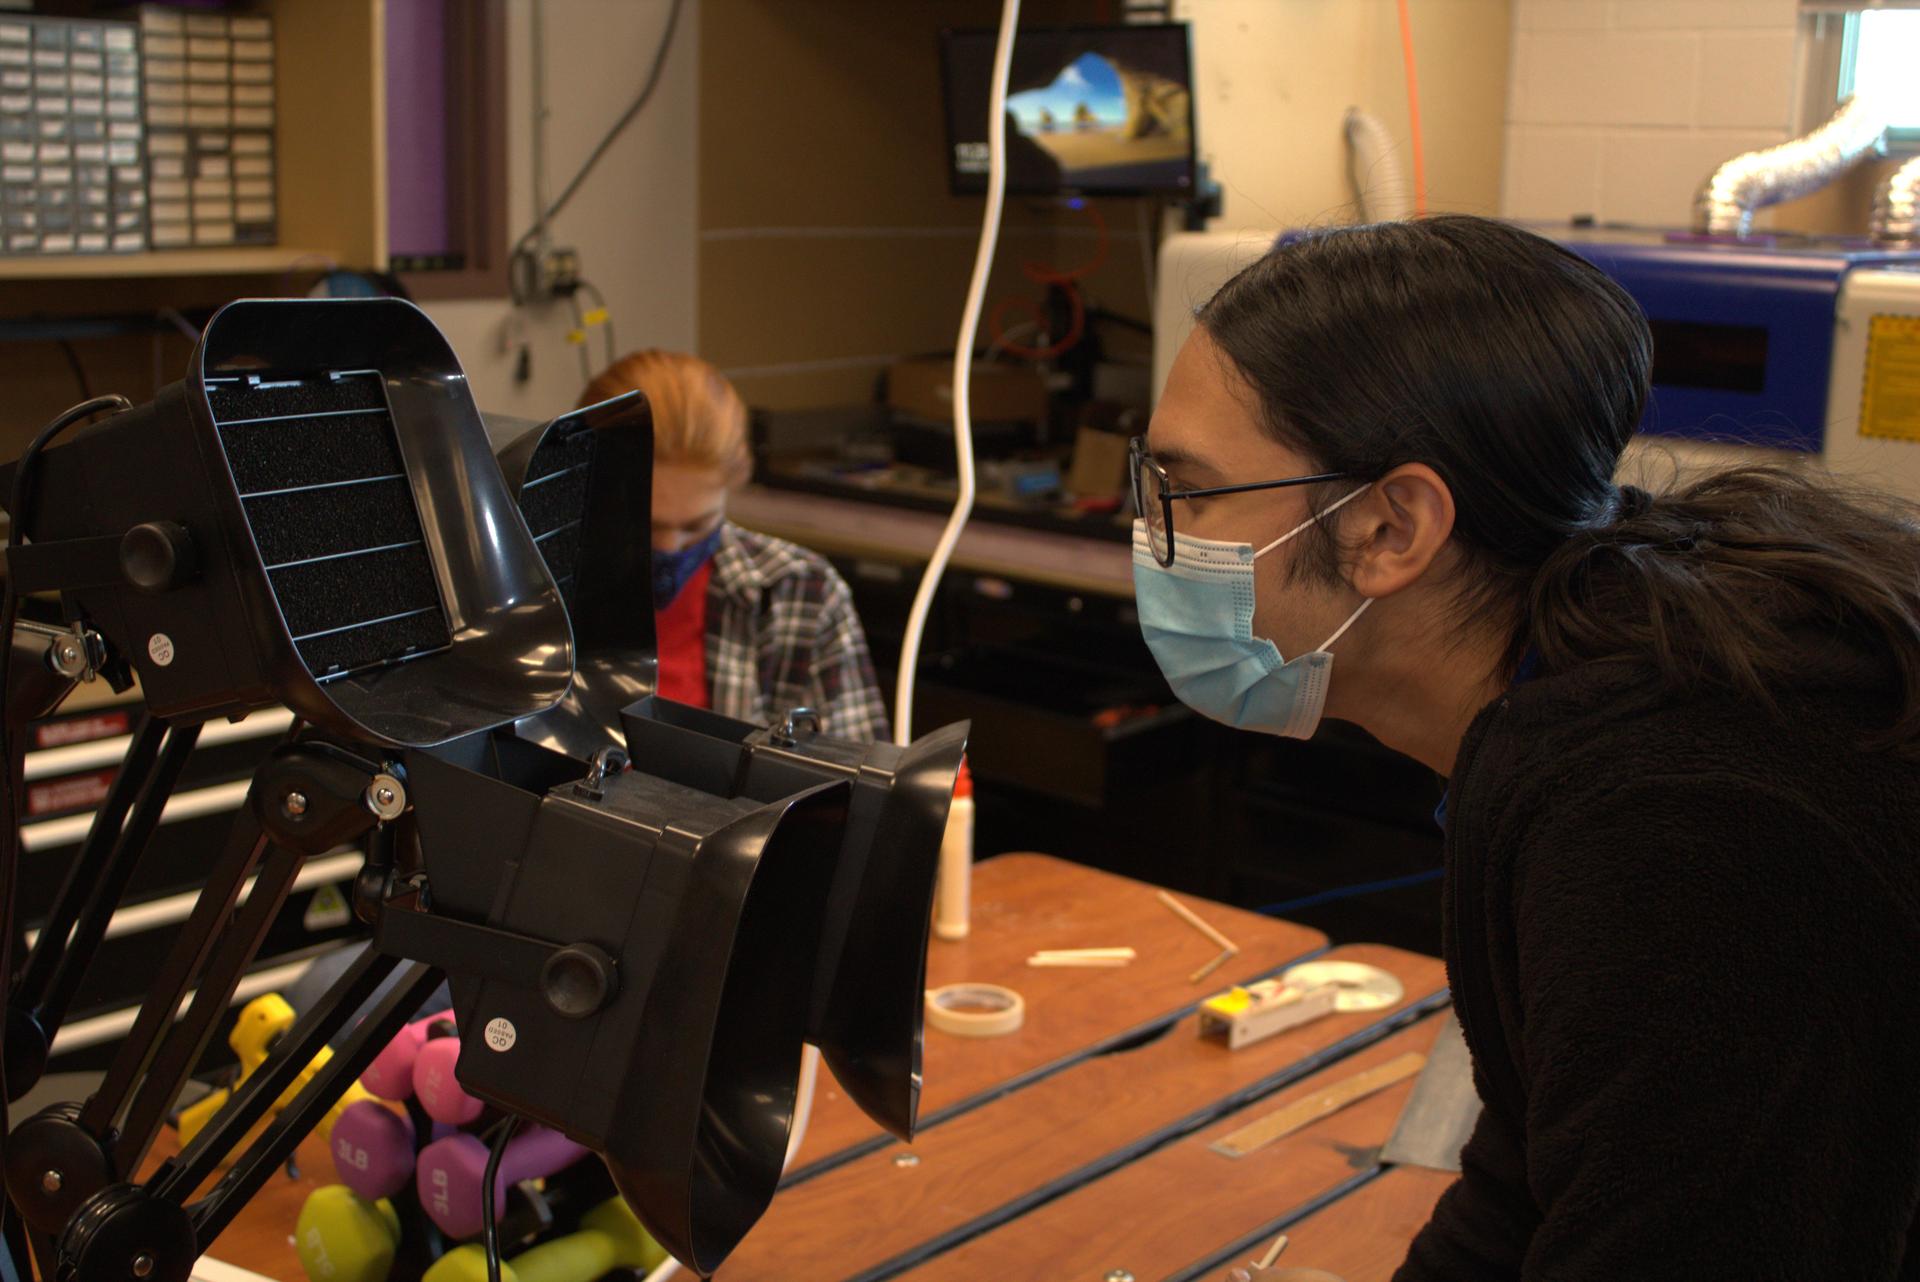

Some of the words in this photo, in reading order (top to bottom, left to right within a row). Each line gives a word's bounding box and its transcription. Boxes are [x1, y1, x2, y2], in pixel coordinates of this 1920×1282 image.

[488, 1026, 513, 1039] PASSED
[492, 1035, 507, 1047] QC
[431, 1167, 449, 1215] 3LB
